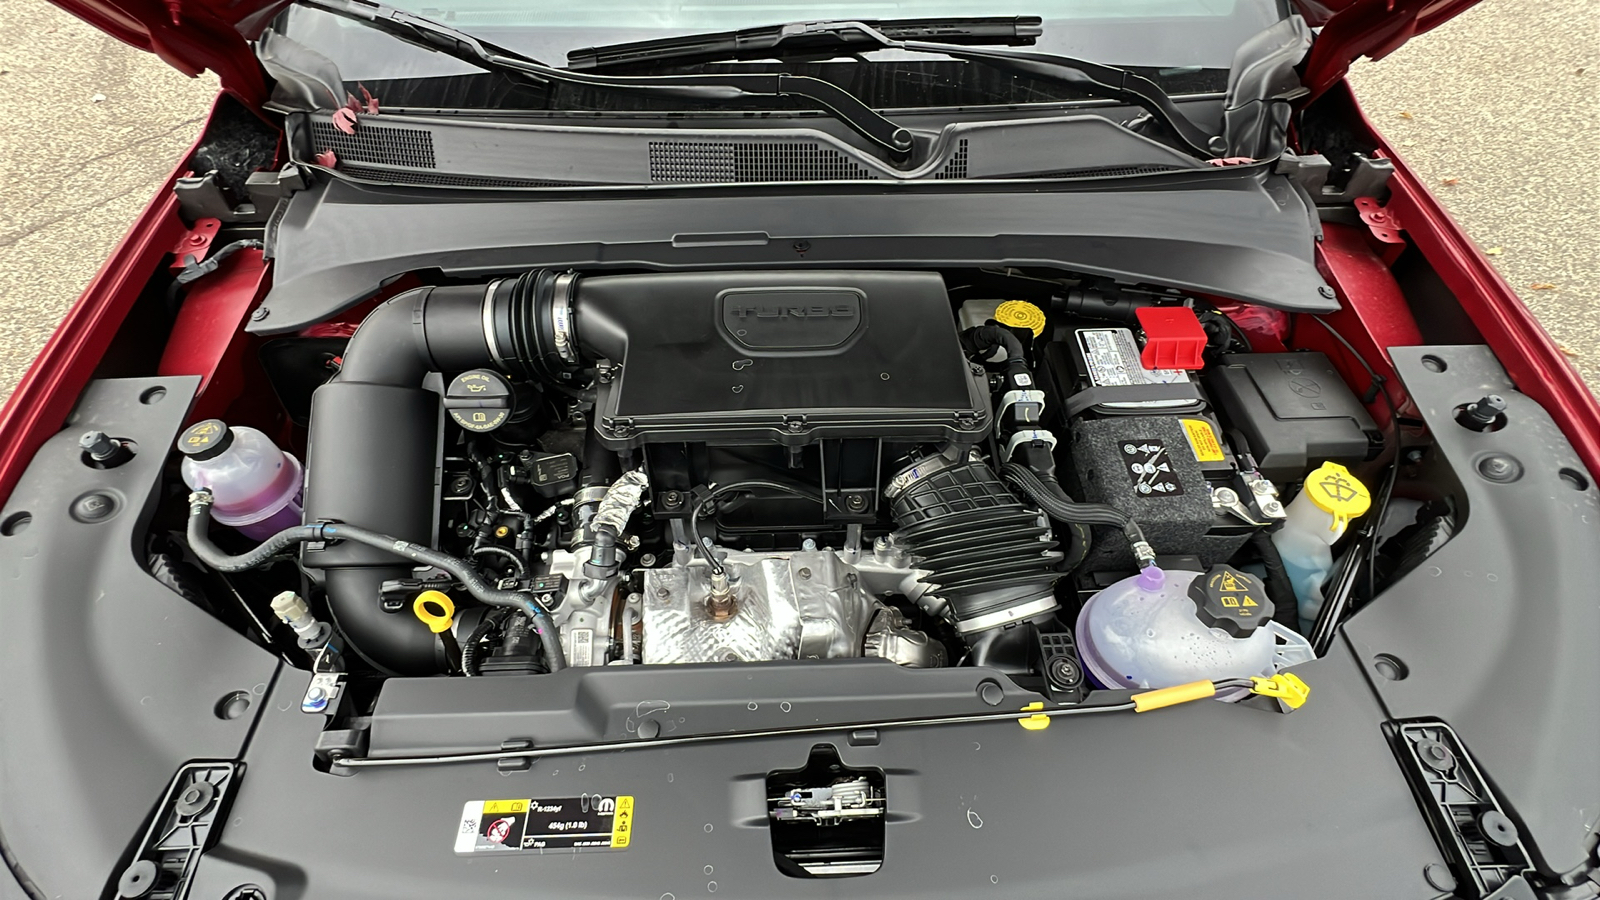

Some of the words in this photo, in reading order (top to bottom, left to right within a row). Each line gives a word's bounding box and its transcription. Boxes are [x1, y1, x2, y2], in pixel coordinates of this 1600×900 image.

[731, 304, 855, 319] TURBO
[461, 374, 480, 383] ENGINE
[481, 375, 490, 383] OIL
[537, 805, 562, 813] R-1234yf
[548, 822, 565, 831] 454g
